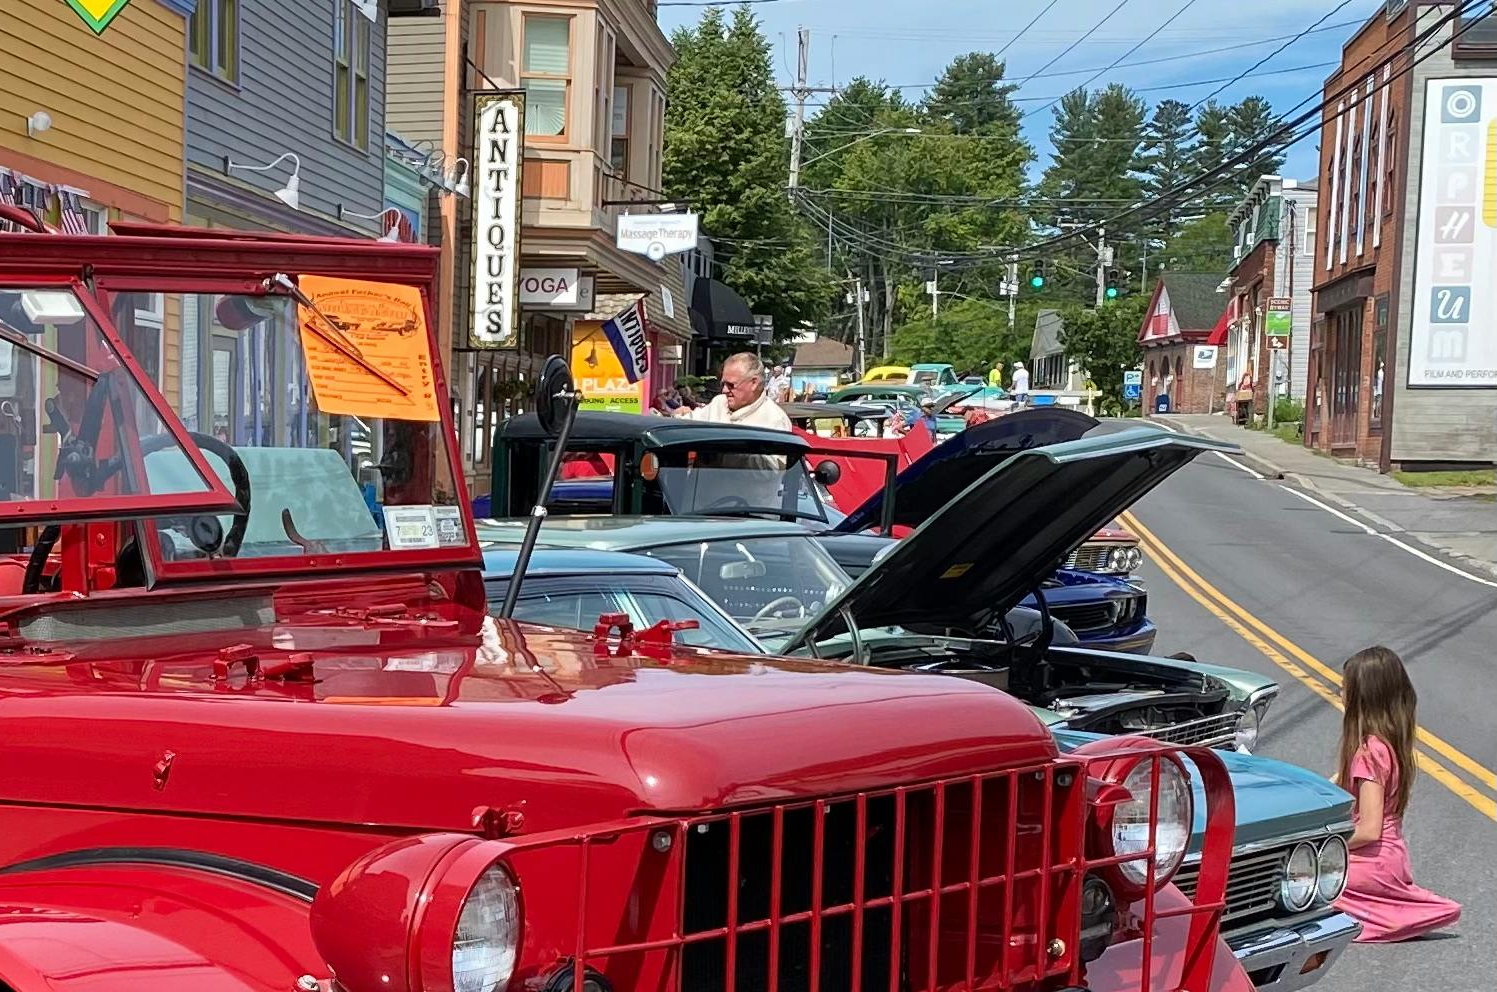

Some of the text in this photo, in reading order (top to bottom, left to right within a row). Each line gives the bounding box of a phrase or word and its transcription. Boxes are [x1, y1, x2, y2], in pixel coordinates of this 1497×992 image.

[486, 107, 511, 335] ANTIQUES
[621, 227, 693, 241] Massage Therapy
[422, 525, 434, 537] 23
